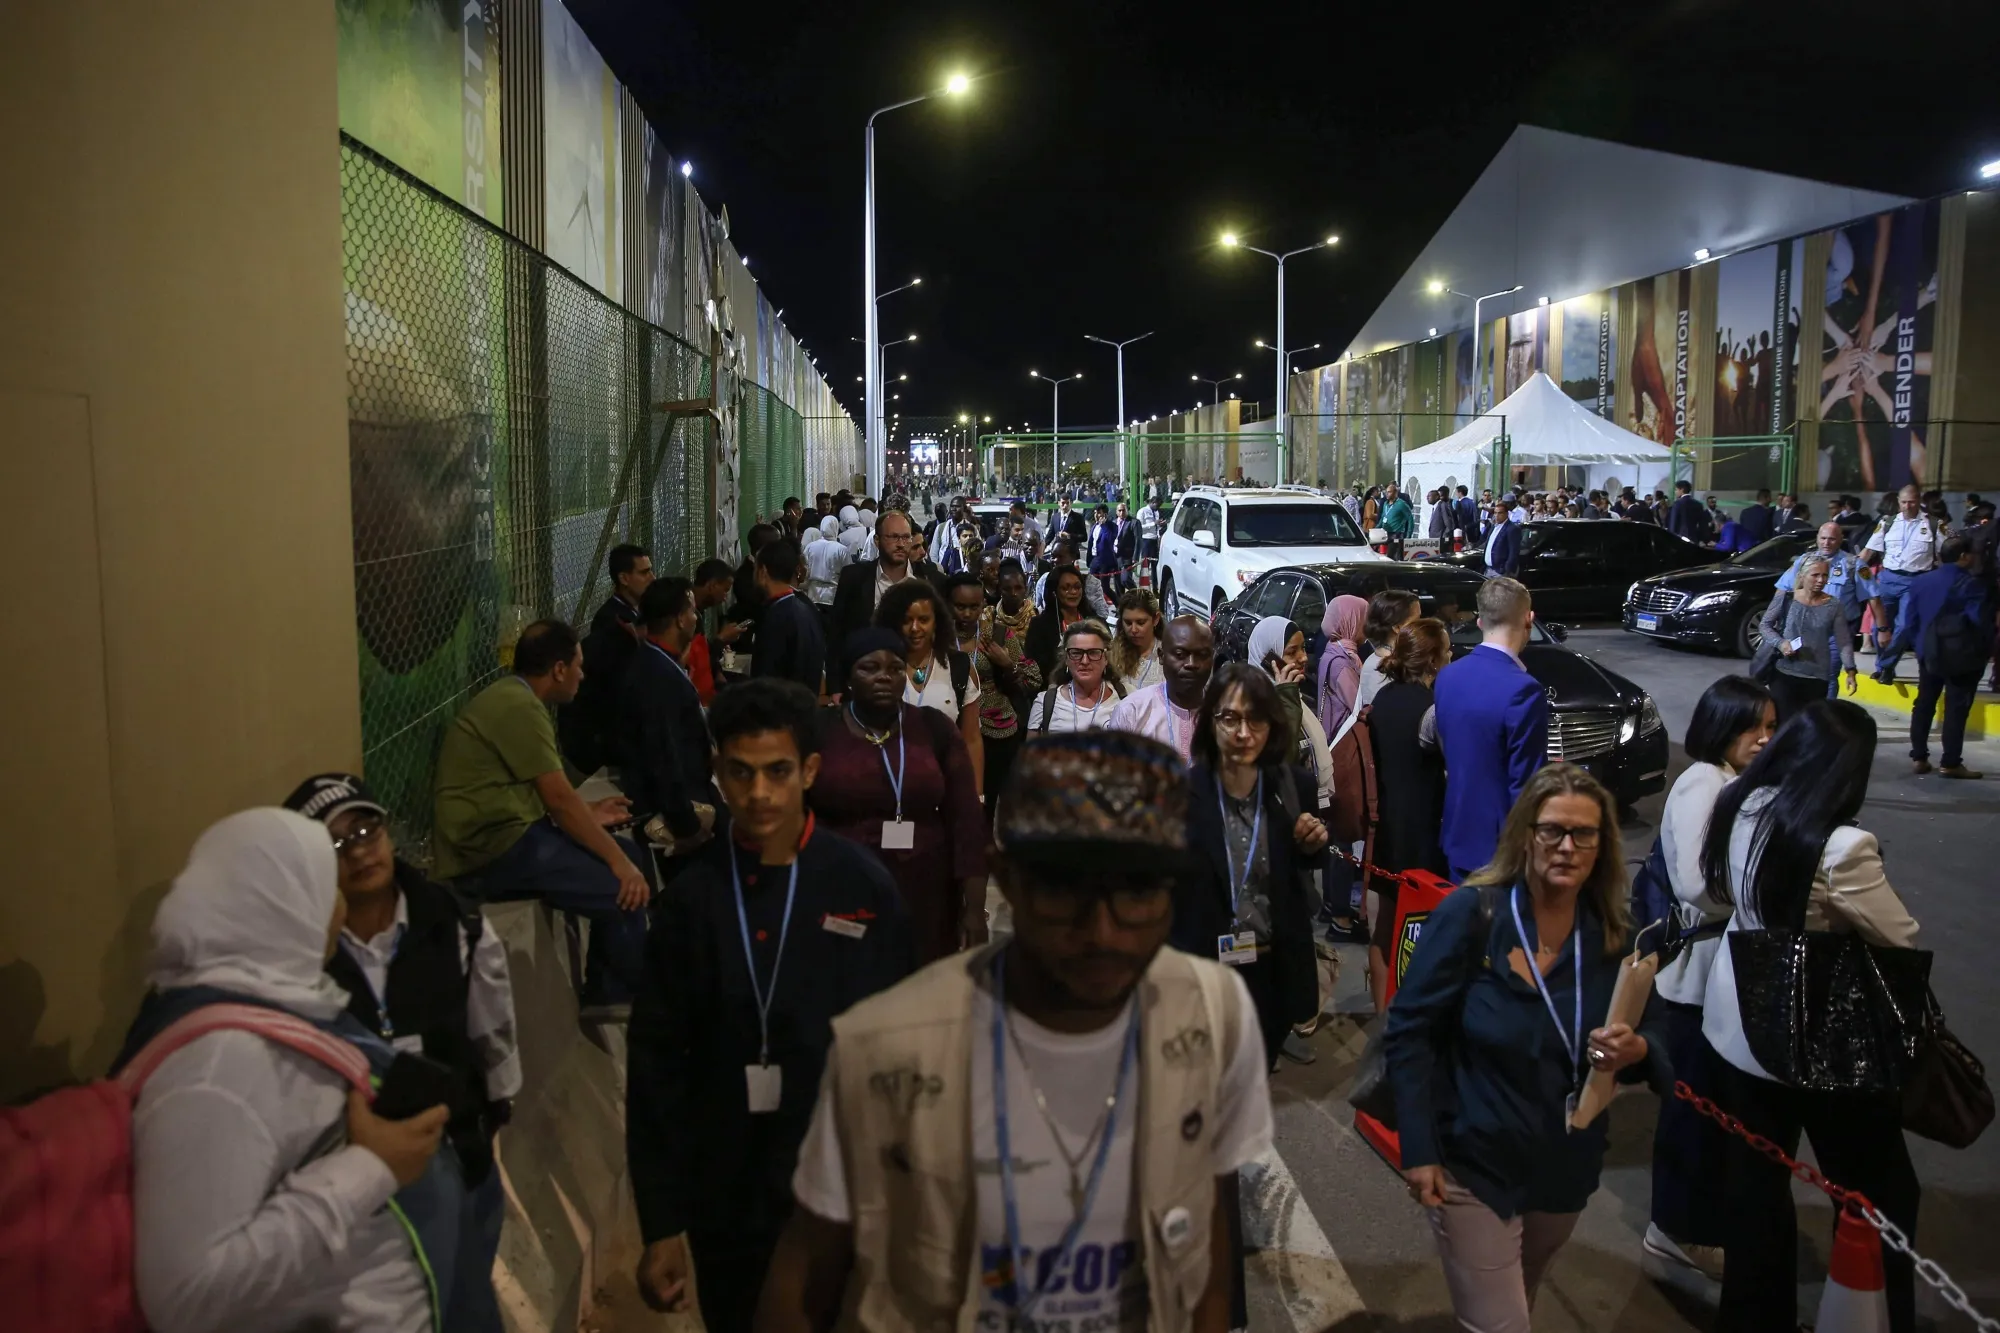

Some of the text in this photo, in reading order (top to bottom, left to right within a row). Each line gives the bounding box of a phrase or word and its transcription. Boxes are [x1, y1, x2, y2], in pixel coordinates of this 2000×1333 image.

[1776, 269, 1787, 343] GENERATIONS
[1675, 310, 1689, 438] ADAPTATION
[1774, 346, 1783, 387] FUTURE
[1895, 316, 1915, 429] GENDER
[1772, 399, 1781, 434] YOUTH
